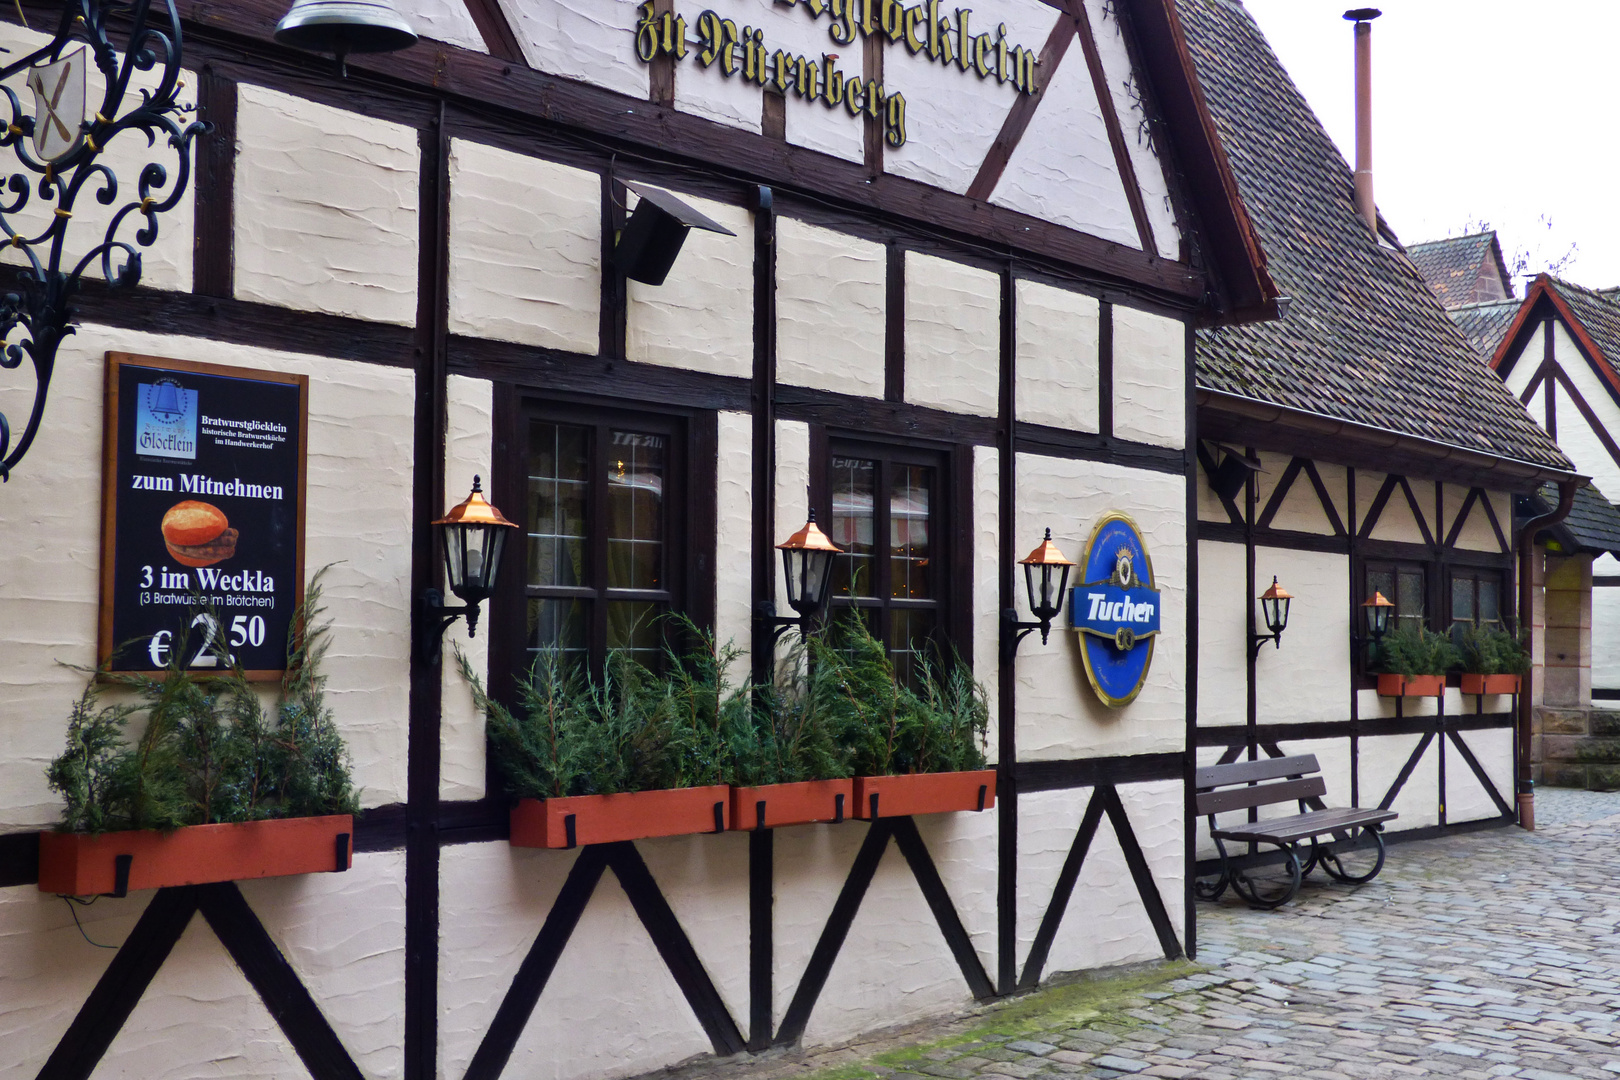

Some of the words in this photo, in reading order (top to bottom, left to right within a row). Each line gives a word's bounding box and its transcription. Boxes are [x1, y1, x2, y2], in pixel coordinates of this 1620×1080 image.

[696, 9, 906, 147] Nürnberg
[201, 415, 287, 433] Bratwurstglöcklein
[202, 427, 236, 437] historische
[237, 431, 286, 442] Bratwurstküche
[140, 431, 193, 452] Glöcklein
[225, 438, 273, 449] Handwerkerhof
[132, 474, 173, 492] zum
[179, 473, 283, 500] Mitnehmen
[140, 565, 153, 588] 3
[161, 566, 189, 589] im
[196, 567, 274, 592] Weckla
[140, 592, 150, 606] (3
[153, 592, 207, 605] Bratwürse
[226, 594, 275, 609] Brötchen)
[1087, 592, 1154, 623] Tucher
[149, 630, 172, 668] €
